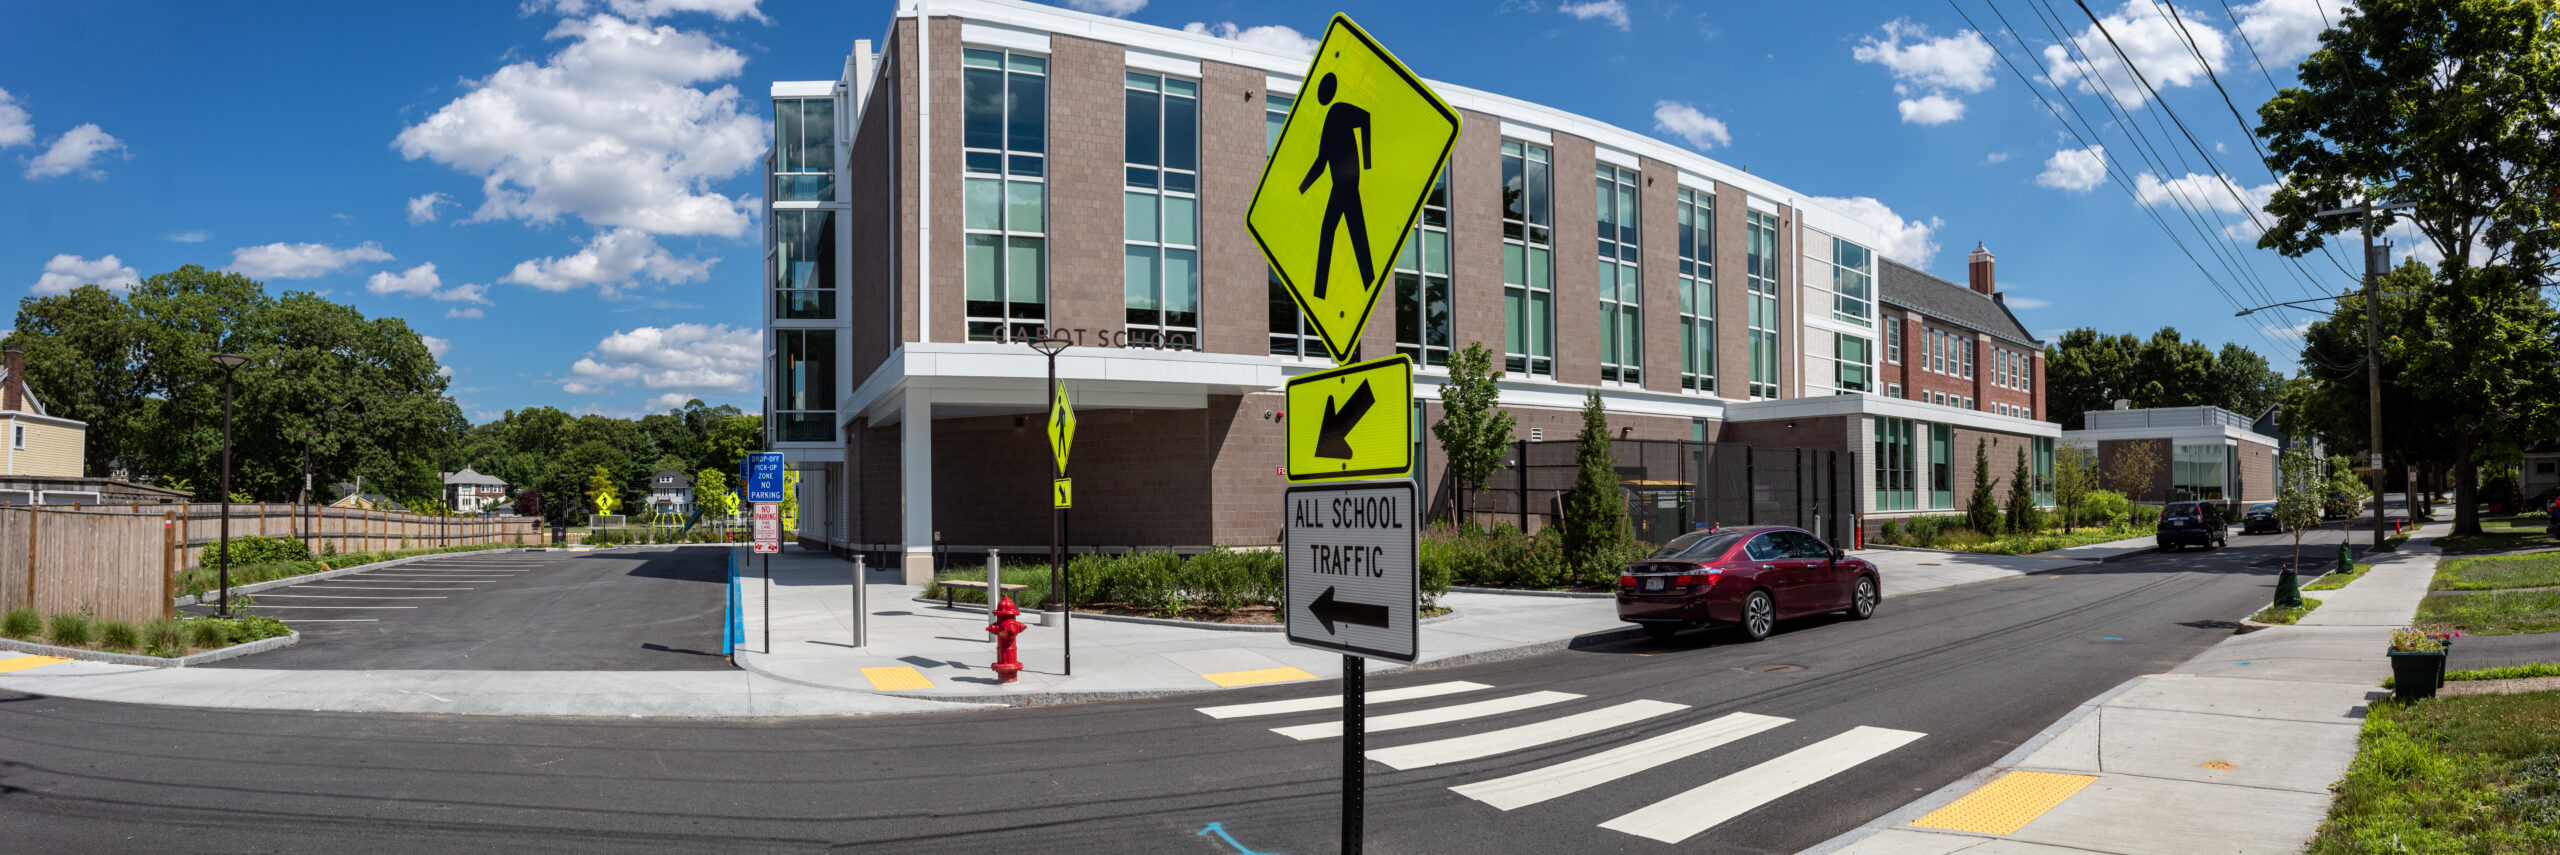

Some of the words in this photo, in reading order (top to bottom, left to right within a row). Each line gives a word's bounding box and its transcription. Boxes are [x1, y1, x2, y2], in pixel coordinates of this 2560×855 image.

[992, 325, 1087, 345] CABOT
[1098, 329, 1202, 352] SCHOOL
[751, 455, 780, 463] DROP-OFF
[758, 472, 774, 480] ZONE
[760, 481, 771, 489] NO
[751, 491, 781, 499] PARKING
[761, 505, 771, 513] NO
[1295, 499, 1324, 528] ALL
[1332, 496, 1403, 529] SCHOOL
[755, 513, 777, 521] PARKING
[1310, 544, 1384, 578] TRAFFIC
